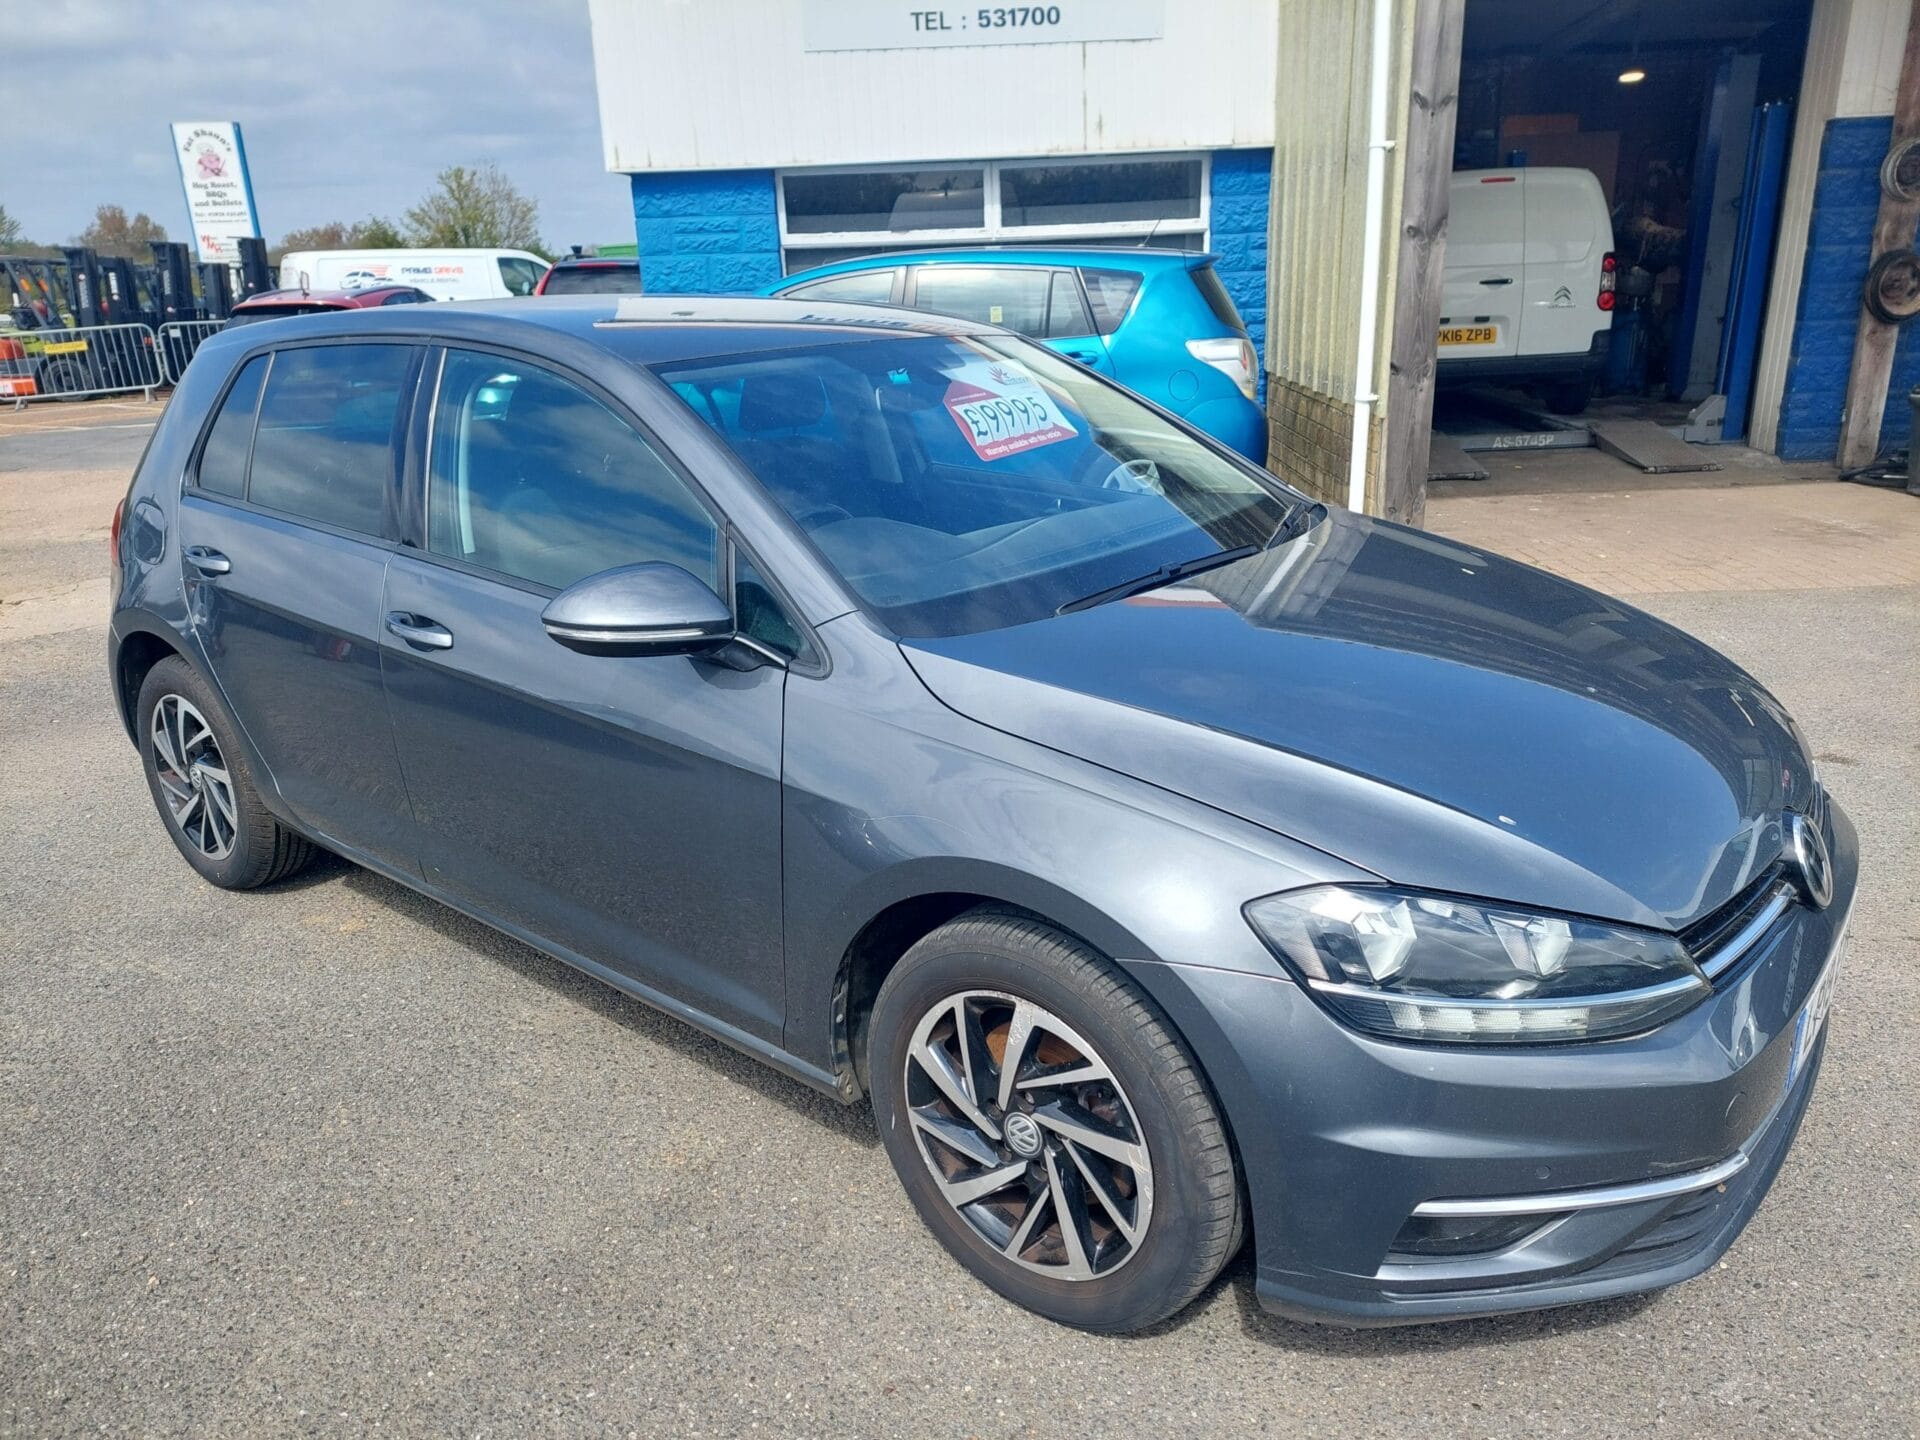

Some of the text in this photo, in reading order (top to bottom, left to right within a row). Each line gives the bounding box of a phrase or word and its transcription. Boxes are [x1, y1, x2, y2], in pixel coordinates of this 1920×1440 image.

[910, 11, 952, 31] TEL
[977, 6, 1061, 28] 531700
[193, 128, 232, 152] Shaun's
[192, 181, 209, 189] Hog
[1466, 328, 1492, 341] ZPB
[962, 396, 1048, 438] £9995
